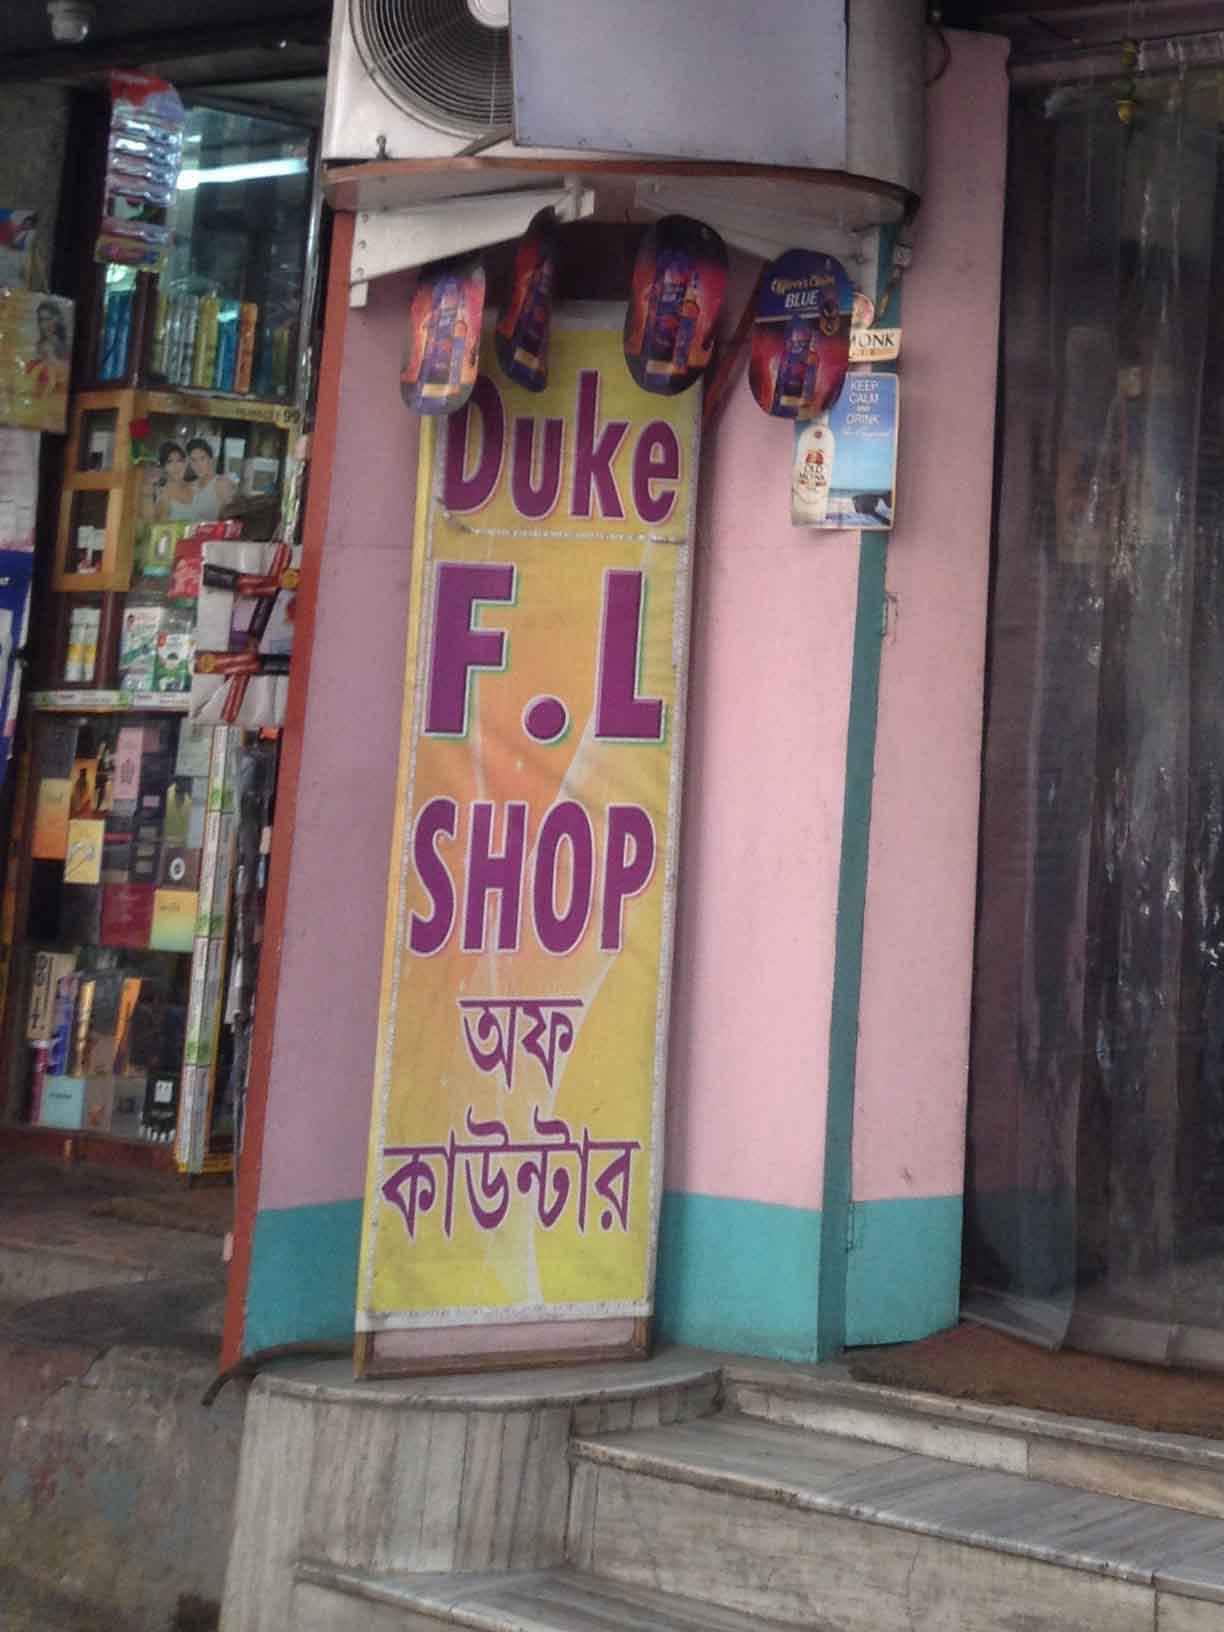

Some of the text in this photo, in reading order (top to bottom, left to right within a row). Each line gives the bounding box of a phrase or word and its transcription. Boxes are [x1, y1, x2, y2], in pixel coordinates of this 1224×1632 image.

[784, 289, 818, 309] BLUE
[443, 368, 682, 525] Duke
[406, 795, 658, 958] SHOP
[458, 997, 585, 1092] অফ
[382, 1105, 641, 1241] কাউন্টার
